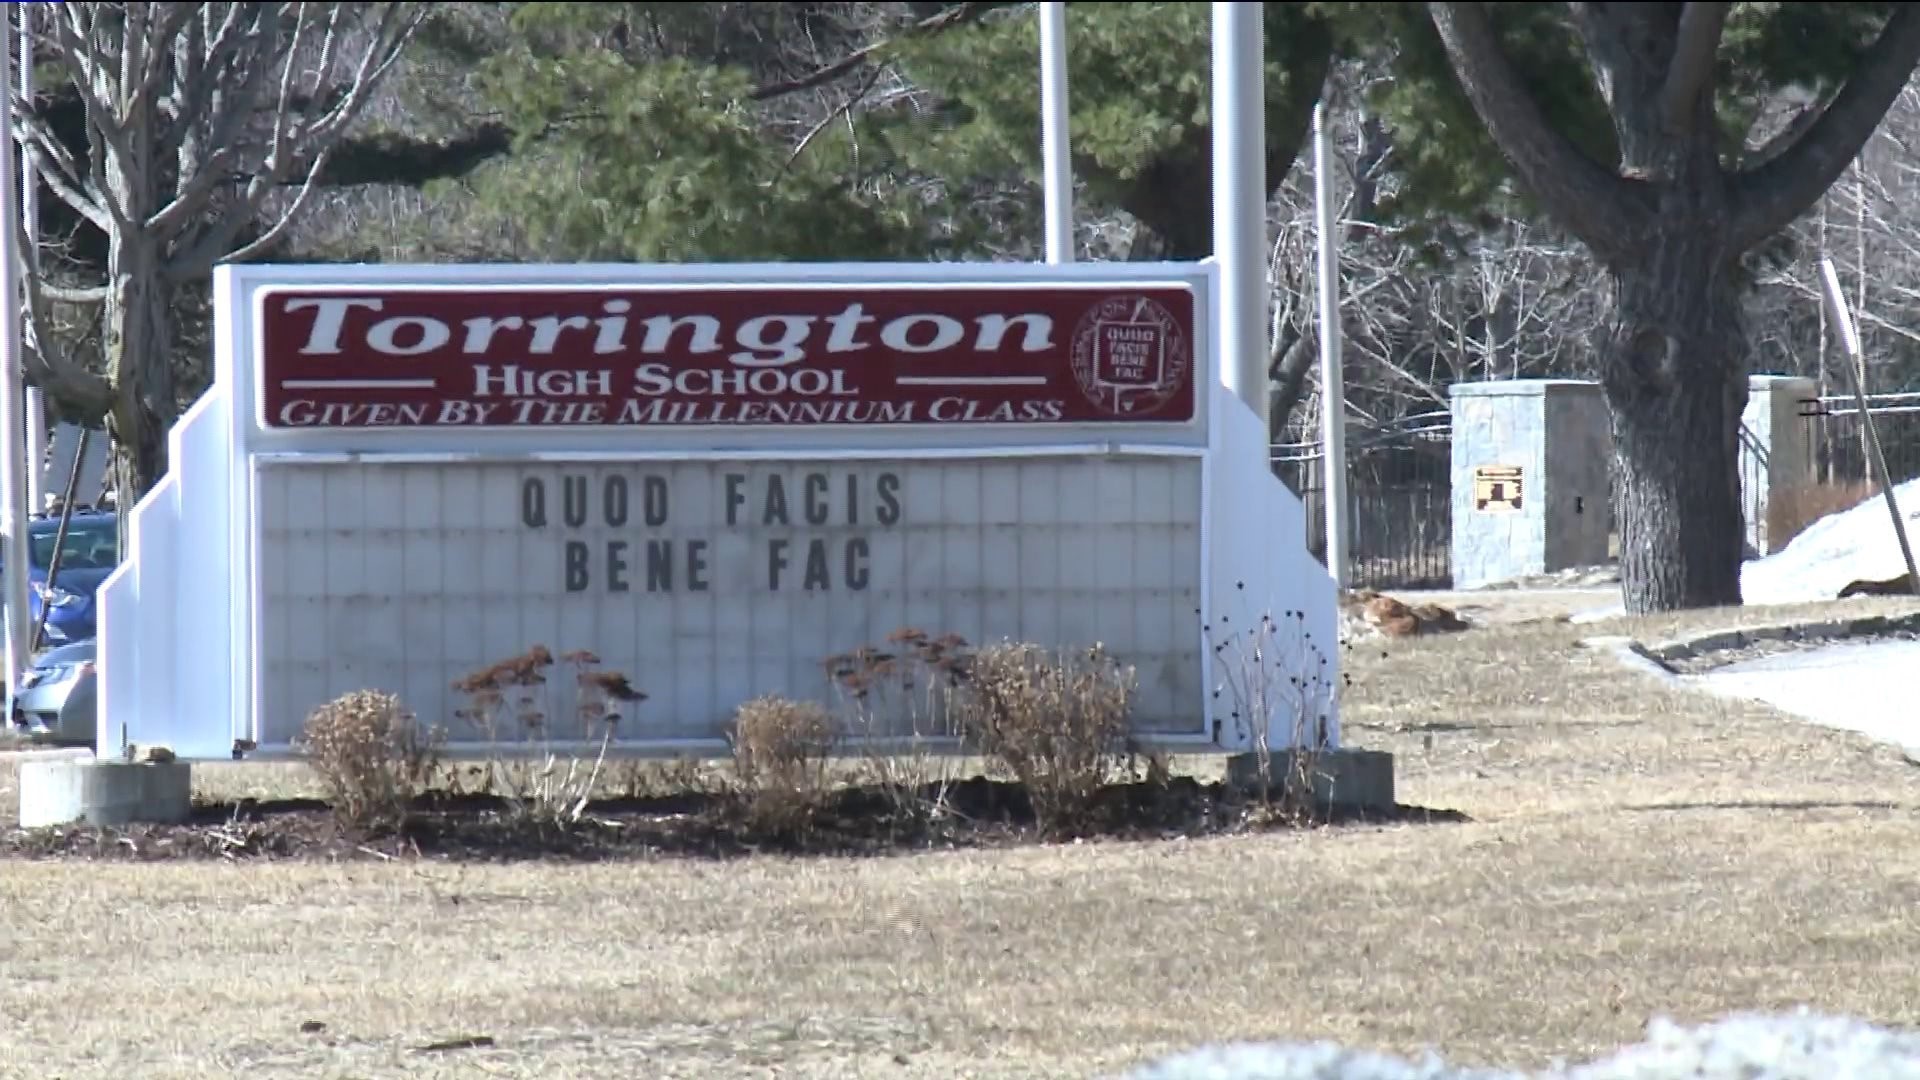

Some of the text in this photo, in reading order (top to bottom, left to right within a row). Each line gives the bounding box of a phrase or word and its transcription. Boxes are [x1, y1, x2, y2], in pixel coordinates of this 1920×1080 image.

[283, 298, 1057, 367] Torrington
[522, 472, 901, 528] QUOD FACIS
[565, 536, 871, 593] BENE FAC
